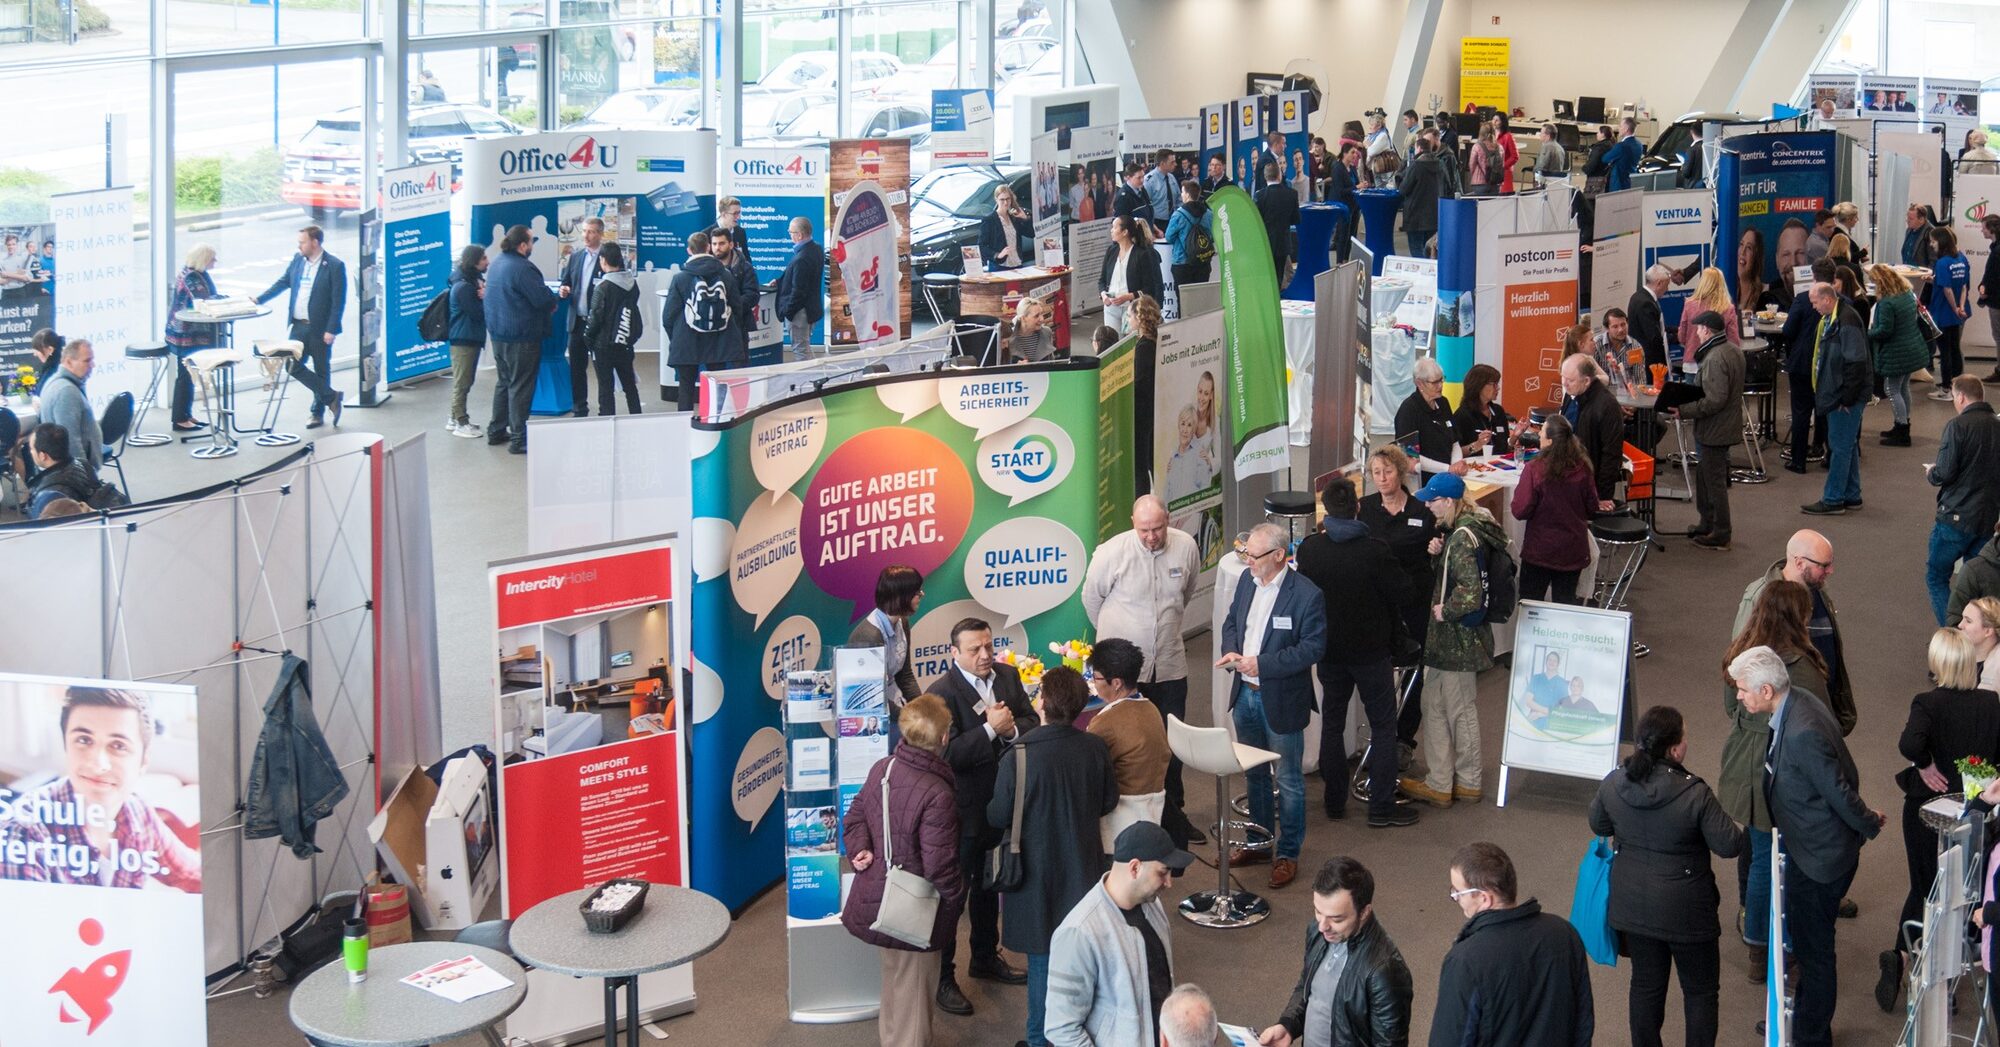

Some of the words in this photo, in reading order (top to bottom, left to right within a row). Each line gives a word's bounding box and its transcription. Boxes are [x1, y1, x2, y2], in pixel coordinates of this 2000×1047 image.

[562, 70, 606, 84] HANNA
[1740, 150, 1767, 161] ncentrix.
[1771, 158, 1826, 166] de.concentrix.com
[500, 180, 595, 196] Personalmanagement
[600, 178, 615, 188] AG
[1740, 182, 1756, 196] EHT
[1758, 179, 1777, 193] FÜR
[55, 200, 128, 219] PRIMARK
[1655, 208, 1701, 220] VENTURA
[1779, 199, 1817, 210] FAMILIE
[55, 232, 128, 252] PRIMARK
[1505, 250, 1555, 267] postcon
[55, 264, 128, 284] PRIMARK
[55, 297, 127, 317] PRIMARK
[1511, 291, 1550, 304] Herzlich
[22, 304, 39, 317] auf
[1510, 302, 1573, 318] willkommen!
[615, 307, 631, 345] PUMA
[1161, 351, 1178, 365] Jobs
[1179, 348, 1190, 359] mit
[1191, 338, 1221, 357] Zukunft?
[960, 381, 1029, 397] ARBEITS-
[960, 396, 1030, 410] SICHERHEIT
[758, 416, 818, 447] HAUSTARIF-
[765, 435, 808, 459] VERTRAG
[991, 451, 1044, 468] START
[820, 480, 862, 507] GUTE
[867, 468, 938, 496] ARBEIT
[820, 507, 850, 537] IST
[856, 492, 936, 527] UNSER
[736, 527, 797, 563] PARTNERSCHAFTLICHE
[819, 519, 944, 567] AUFTRAG.
[737, 540, 796, 581] AUSBILDUNG
[984, 547, 1067, 568] QUALIFI-
[505, 569, 597, 595] IntercityHotel
[984, 569, 1068, 589] ZIERUNG
[1532, 626, 1569, 639] Helden
[1572, 632, 1617, 646] gesucht.
[772, 634, 811, 668] ZEIT-
[579, 756, 630, 774] COMFORT
[737, 748, 783, 783] GESUNDHEITS-
[580, 772, 615, 787] MEETS
[616, 765, 648, 779] STYLE
[737, 761, 784, 801] FÖRDERUNG
[109, 838, 170, 876] los.
